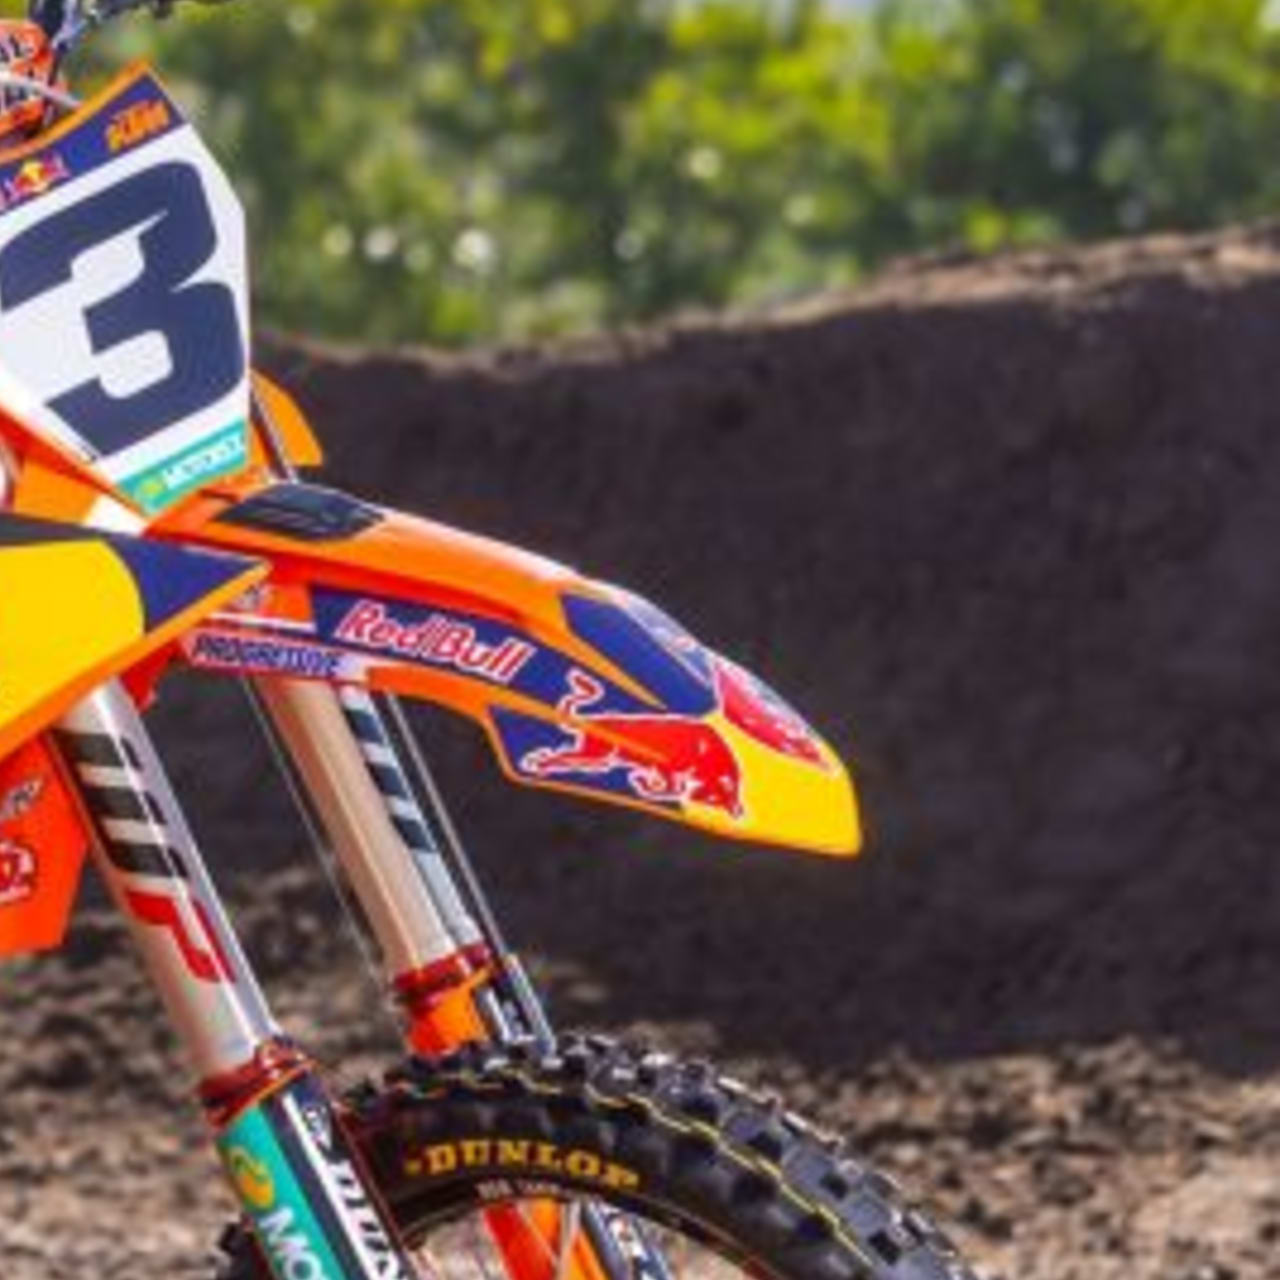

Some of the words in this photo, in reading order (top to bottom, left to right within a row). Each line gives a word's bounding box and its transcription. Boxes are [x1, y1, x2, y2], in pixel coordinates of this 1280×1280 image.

[336, 599, 443, 658] Red
[426, 622, 537, 685] Bull
[424, 1138, 640, 1188] DUNLOP
